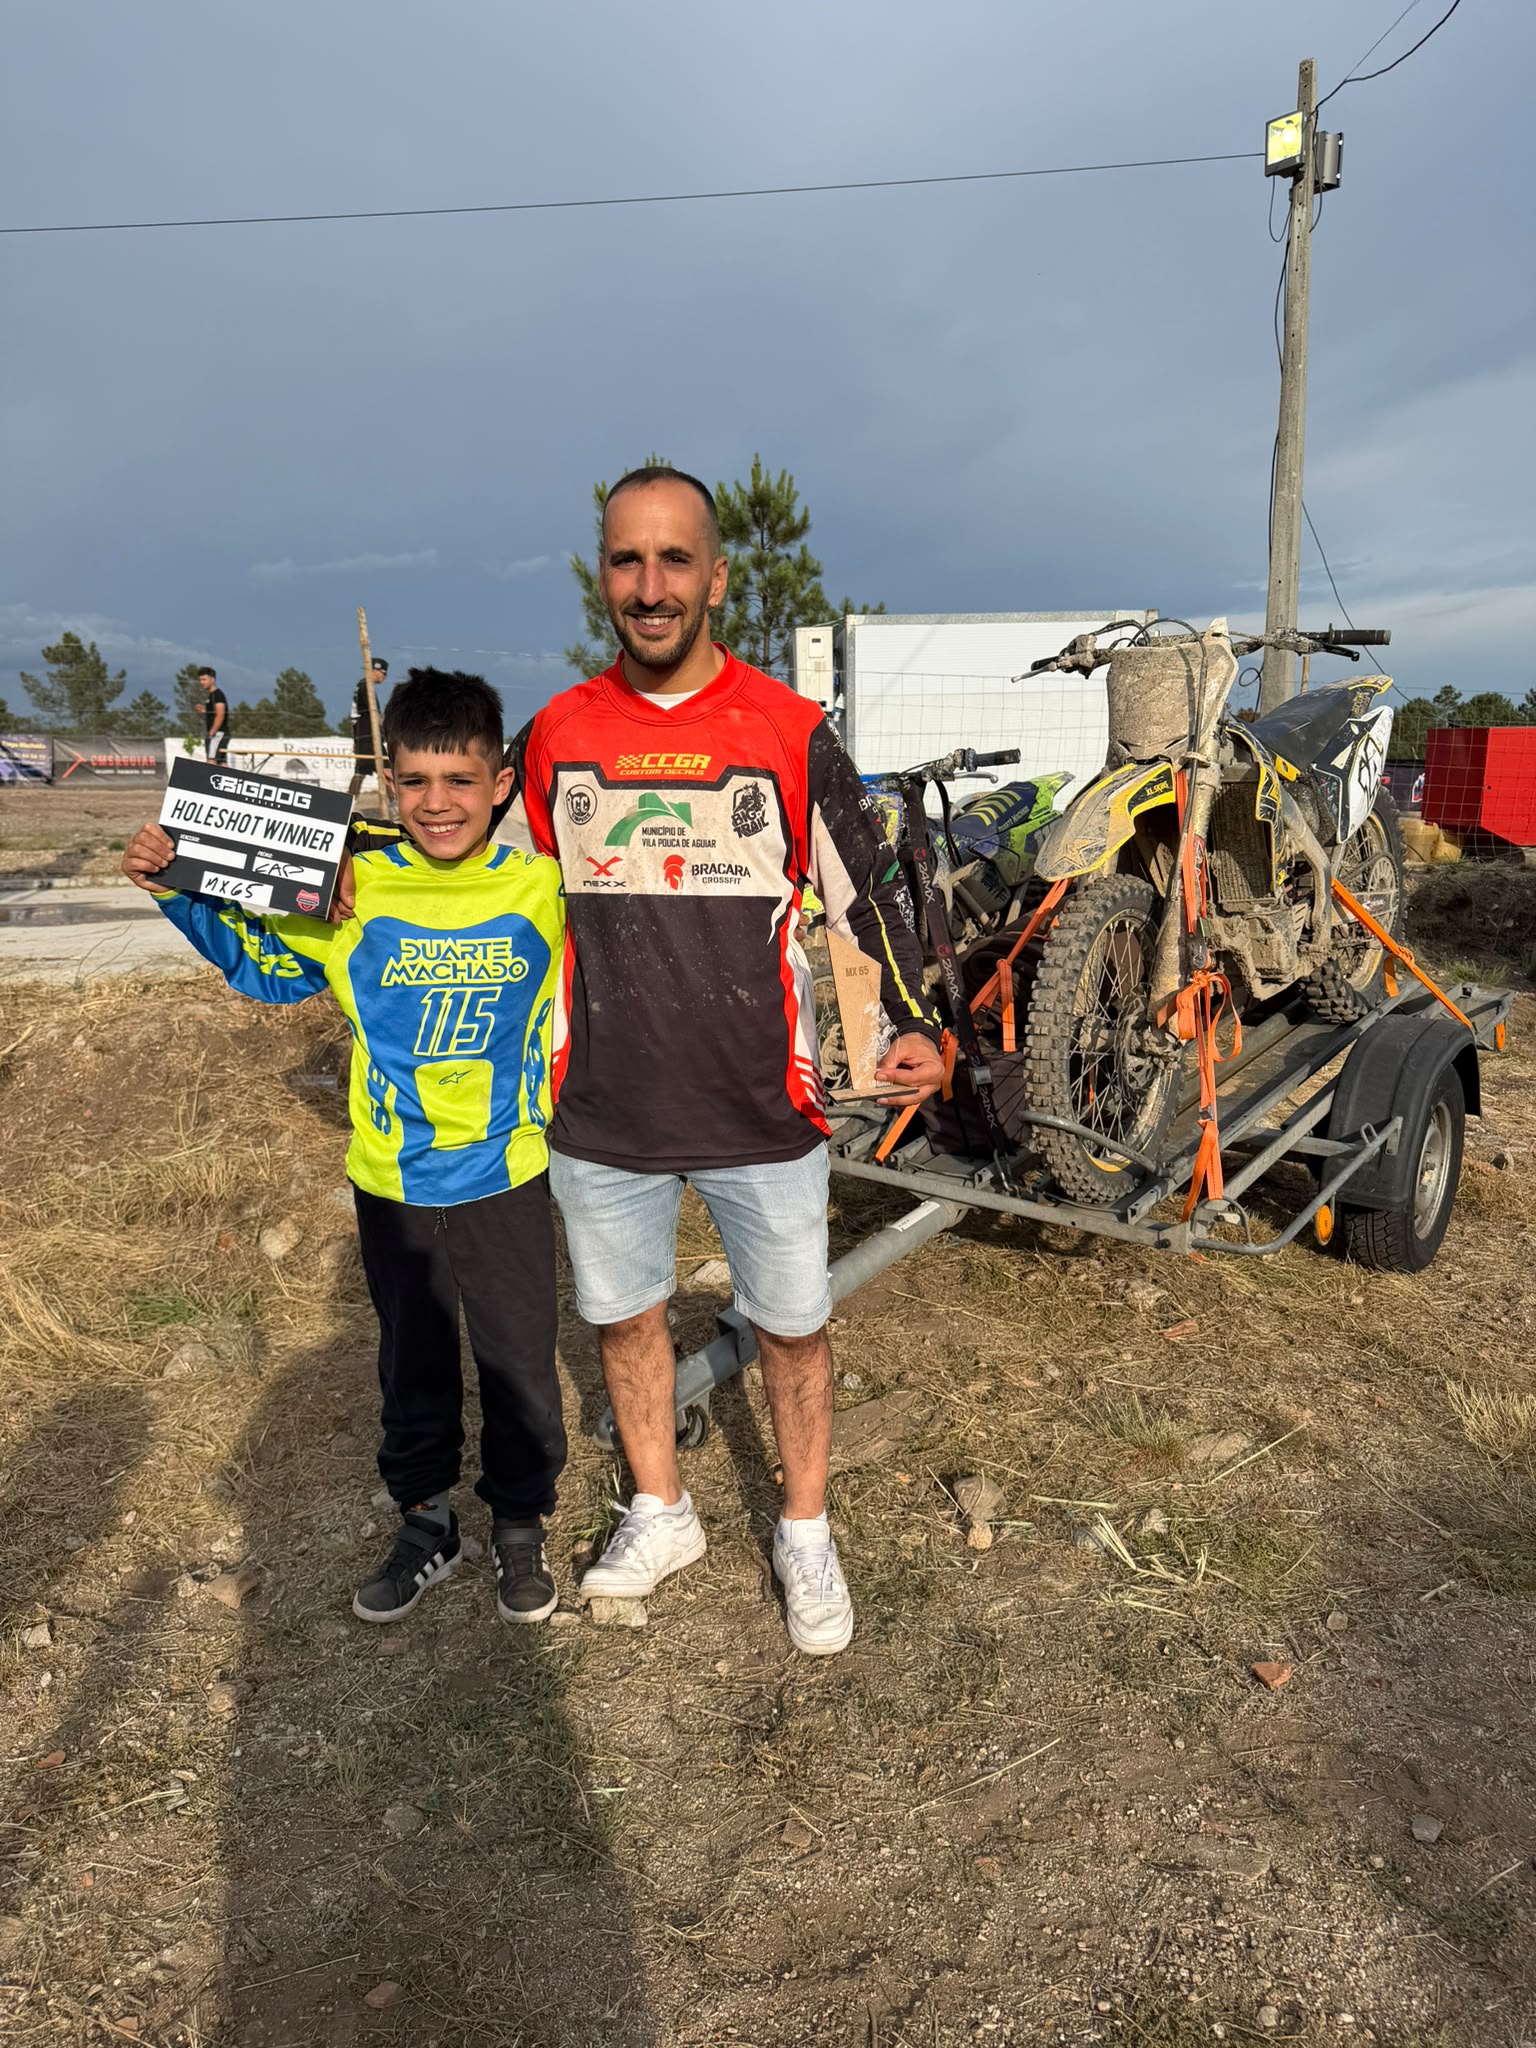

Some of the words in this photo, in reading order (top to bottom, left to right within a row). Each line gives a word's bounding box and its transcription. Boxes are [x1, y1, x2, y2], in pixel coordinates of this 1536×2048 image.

[641, 753, 711, 769] CCGR
[171, 799, 263, 836] HOLESHOT
[263, 818, 334, 852] WINNER
[731, 809, 757, 827] BIG
[642, 825, 676, 836] MUNICÍPIO
[677, 827, 686, 836] DE
[733, 816, 769, 838] TRAIL
[642, 838, 656, 847] VILA
[658, 838, 680, 847] POUCA
[682, 839, 690, 848] DE
[691, 839, 716, 848] AGUIAR
[691, 863, 751, 878] BRACARA
[702, 876, 742, 885] CROSSFIT
[401, 938, 511, 961] DUARTE
[382, 957, 528, 986] MACHADO
[845, 967, 857, 977] MX
[859, 966, 869, 975] 65
[414, 986, 502, 1056] 115
